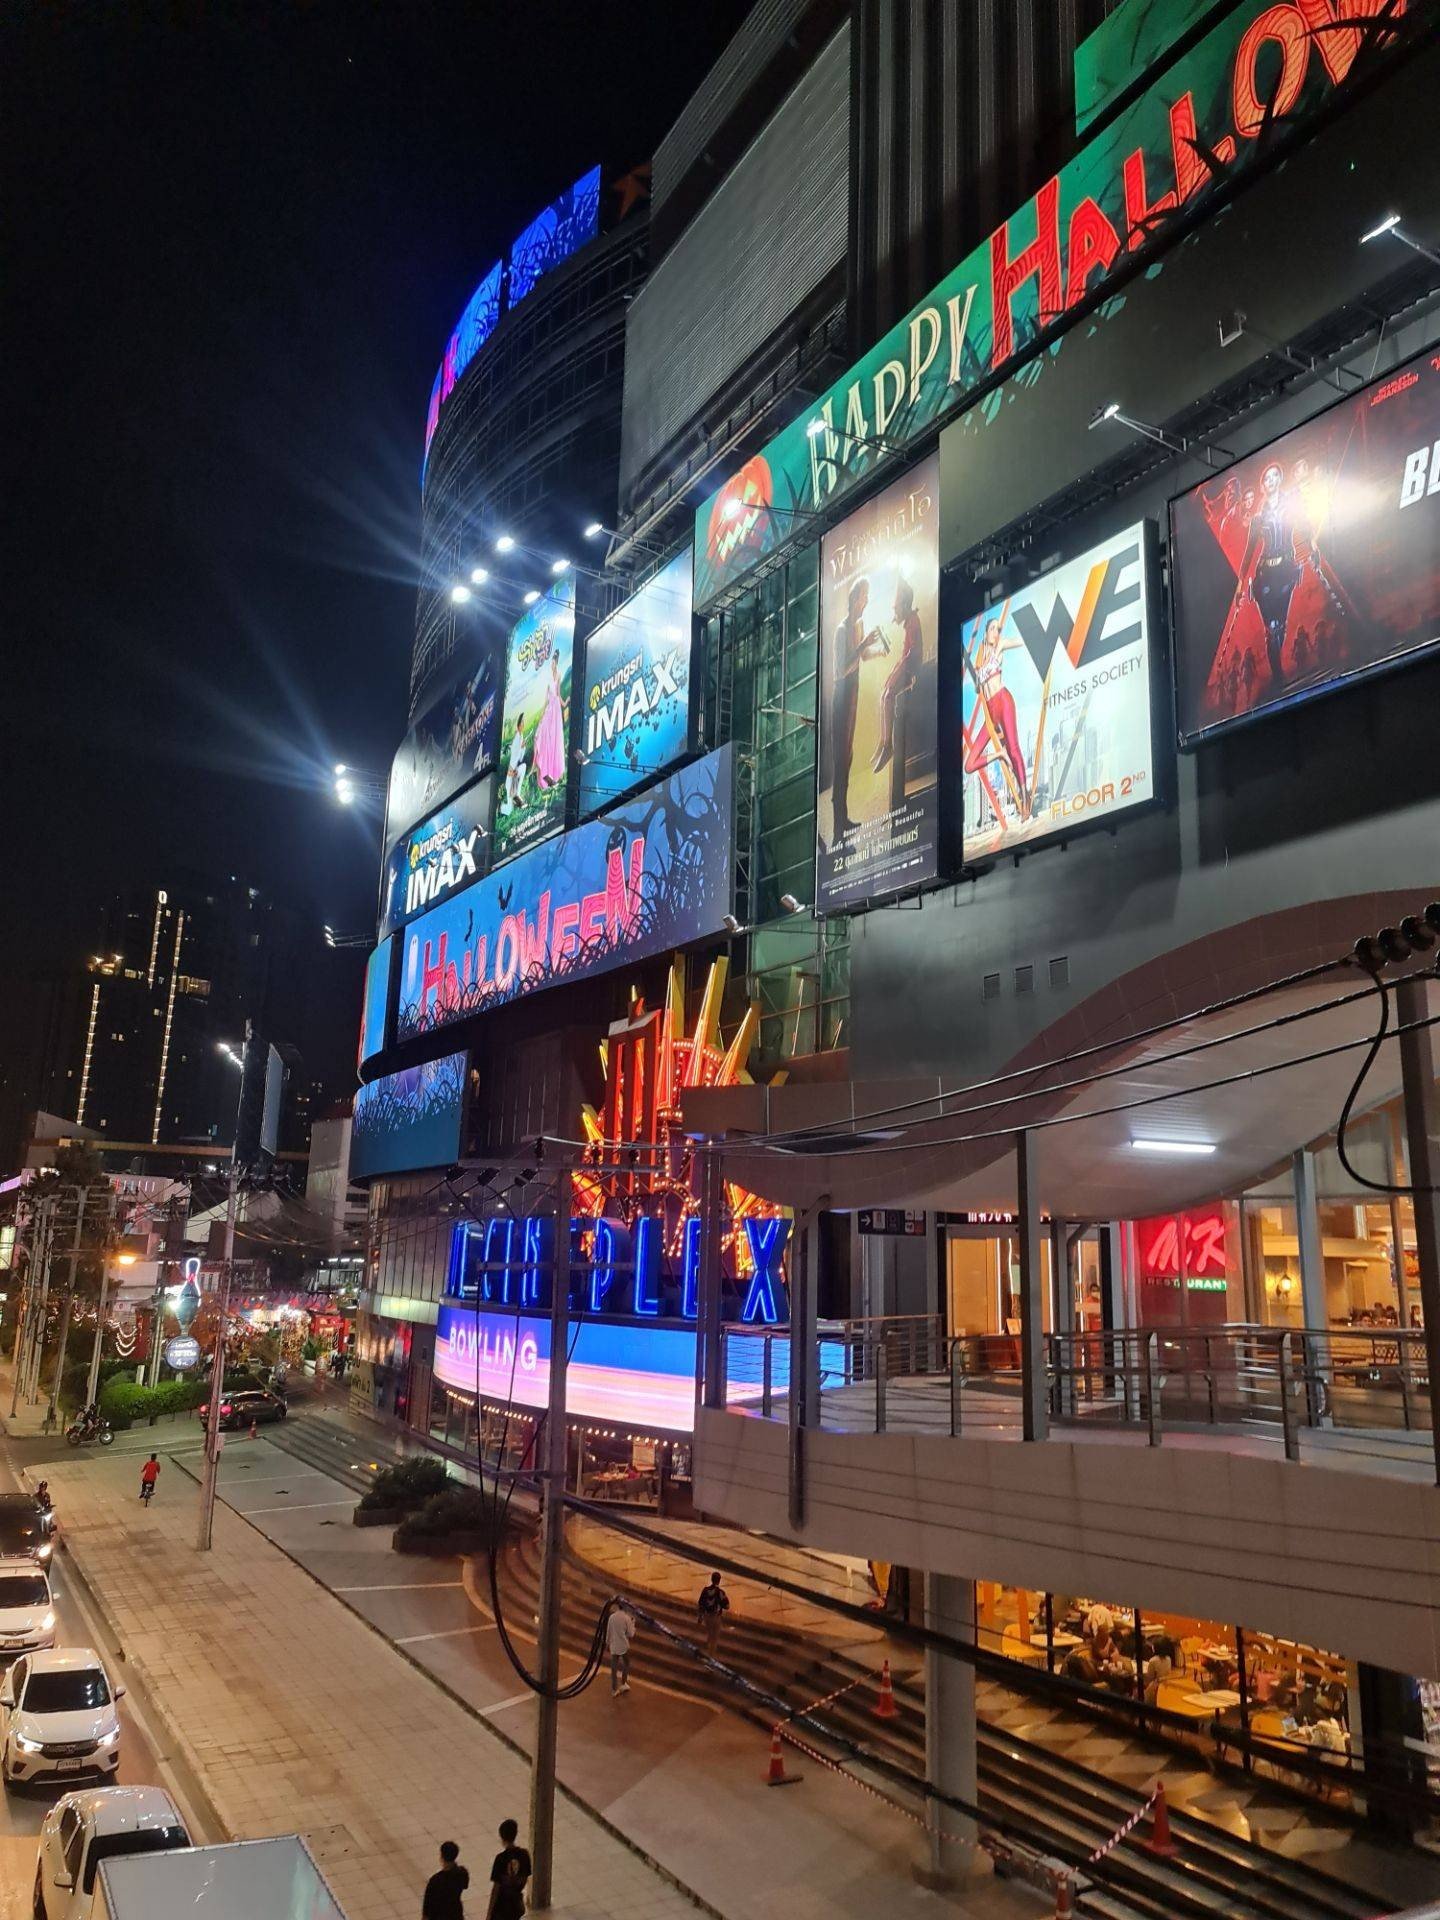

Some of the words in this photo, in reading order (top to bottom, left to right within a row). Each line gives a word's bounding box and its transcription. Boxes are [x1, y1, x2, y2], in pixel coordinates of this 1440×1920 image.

[807, 284, 978, 502] HAPPY
[1370, 373, 1418, 407] JOHANSSON
[1011, 542, 1142, 684] WE
[601, 647, 643, 698] krungsri
[1043, 681, 1087, 708] FITNESS
[1092, 654, 1144, 690] SOCIETY
[588, 648, 678, 755] IMAX
[1051, 783, 1116, 820] FLOOR
[405, 830, 479, 915] IMAX
[833, 857, 844, 872] 22
[1147, 1217, 1236, 1273] MK
[448, 1327, 538, 1371] BOWLING
